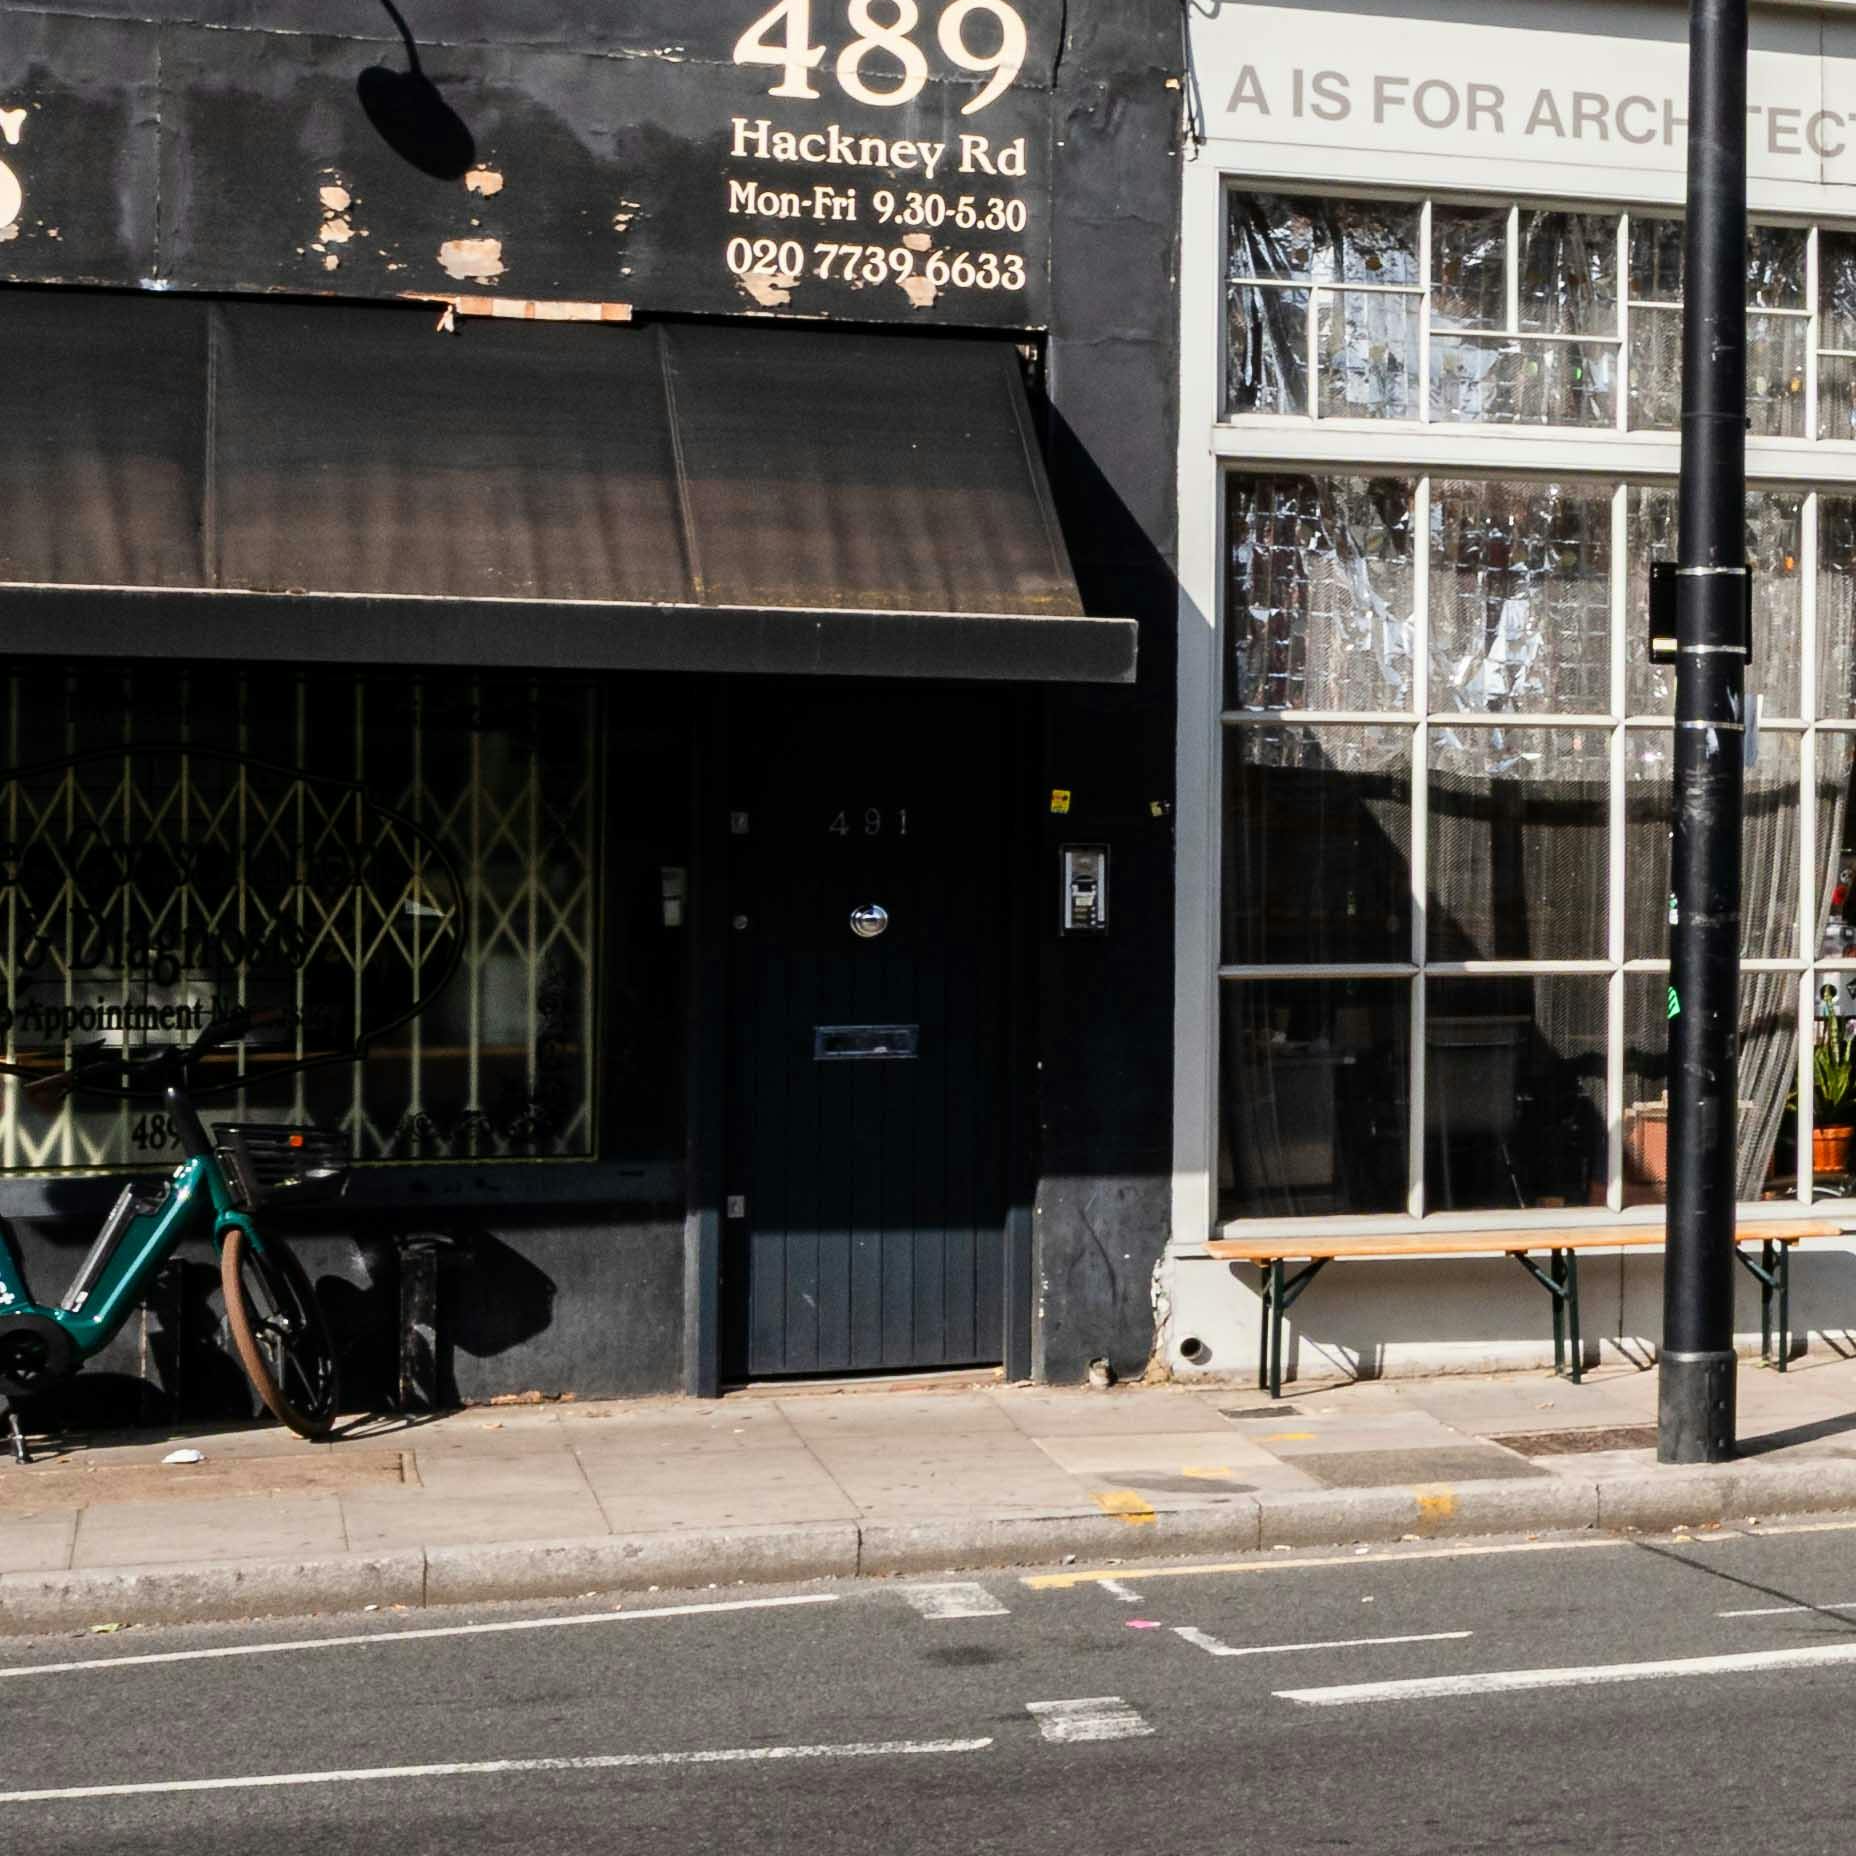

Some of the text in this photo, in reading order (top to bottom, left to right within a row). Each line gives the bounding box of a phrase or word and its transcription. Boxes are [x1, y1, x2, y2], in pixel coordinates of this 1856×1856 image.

[1226, 64, 1271, 115] A
[1291, 69, 1351, 122] IS
[1373, 75, 1506, 134] FOR
[730, 117, 1027, 179] Hackney Rd
[728, 180, 1028, 233] Mon-Fri 9.30-5.30
[726, 237, 1027, 291] 020 7739 6633
[828, 808, 912, 839] 491
[21, 994, 204, 1041] Appointment
